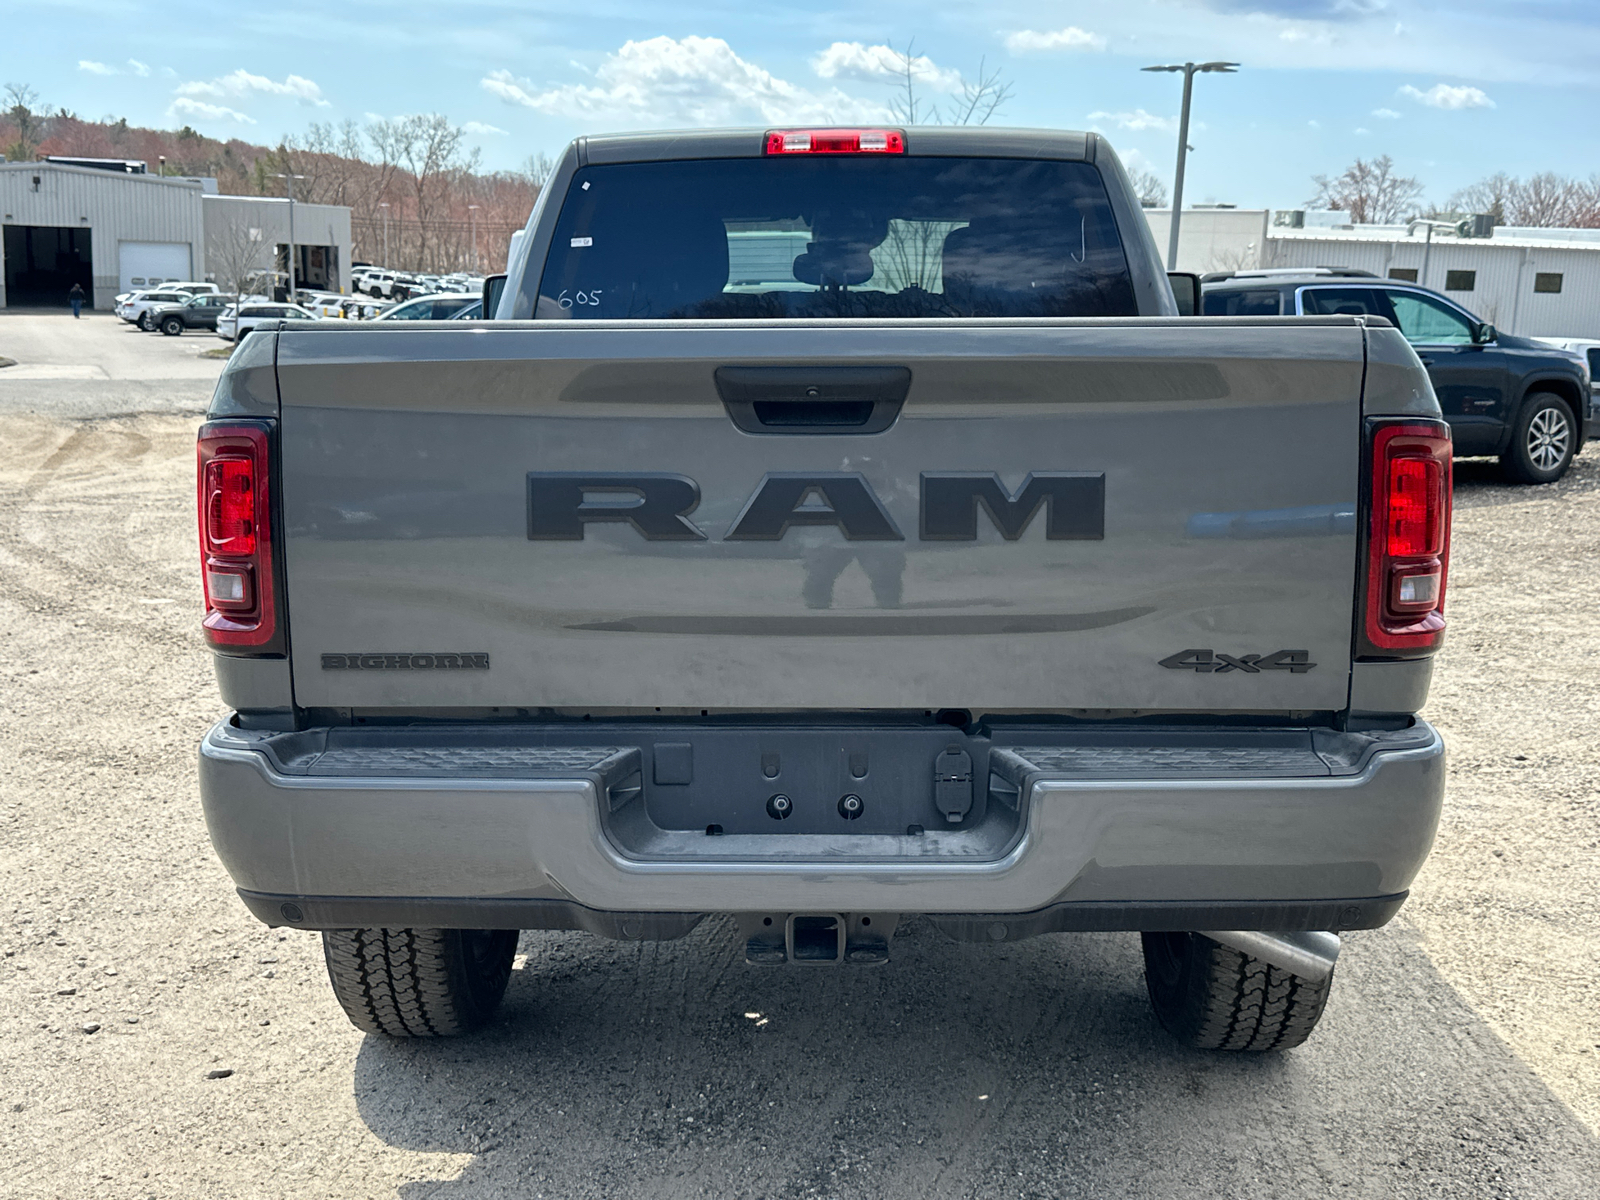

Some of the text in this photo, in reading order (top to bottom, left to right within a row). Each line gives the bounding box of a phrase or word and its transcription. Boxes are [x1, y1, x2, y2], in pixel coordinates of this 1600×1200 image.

[558, 289, 602, 310] 605
[526, 471, 1105, 541] RAM
[321, 653, 490, 670] BIGHORN
[1158, 649, 1317, 673] 4x4
